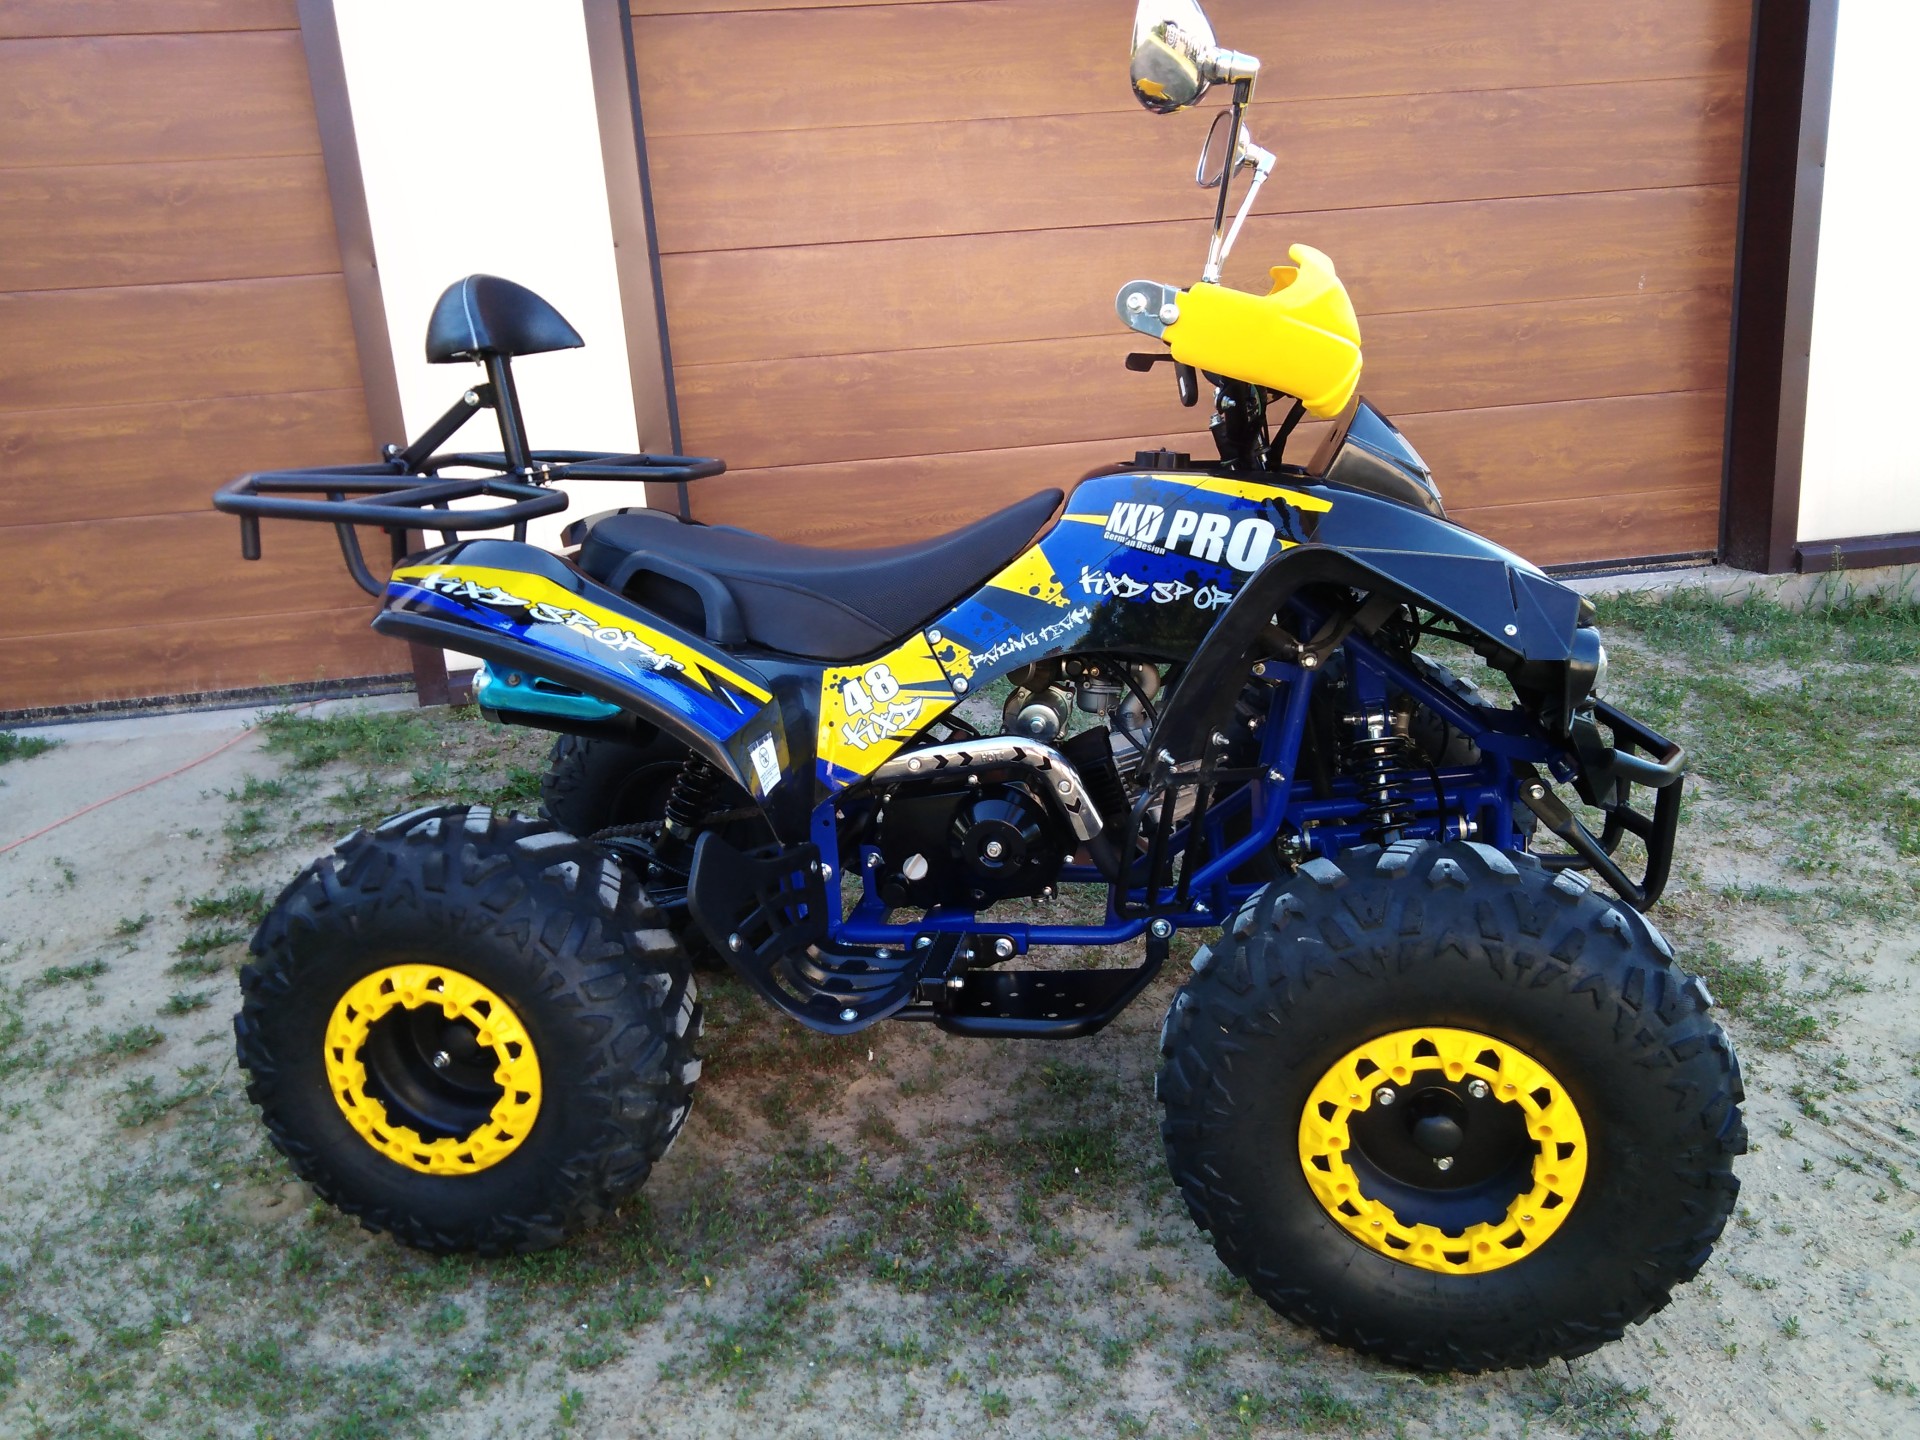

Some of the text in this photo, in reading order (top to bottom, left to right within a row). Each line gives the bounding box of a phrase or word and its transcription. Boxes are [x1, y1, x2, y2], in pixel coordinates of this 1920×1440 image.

[1103, 530, 1166, 556] German Design
[1105, 501, 1276, 572] KXD PRO
[1151, 579, 1233, 611] SPOR
[842, 663, 901, 717] 48
